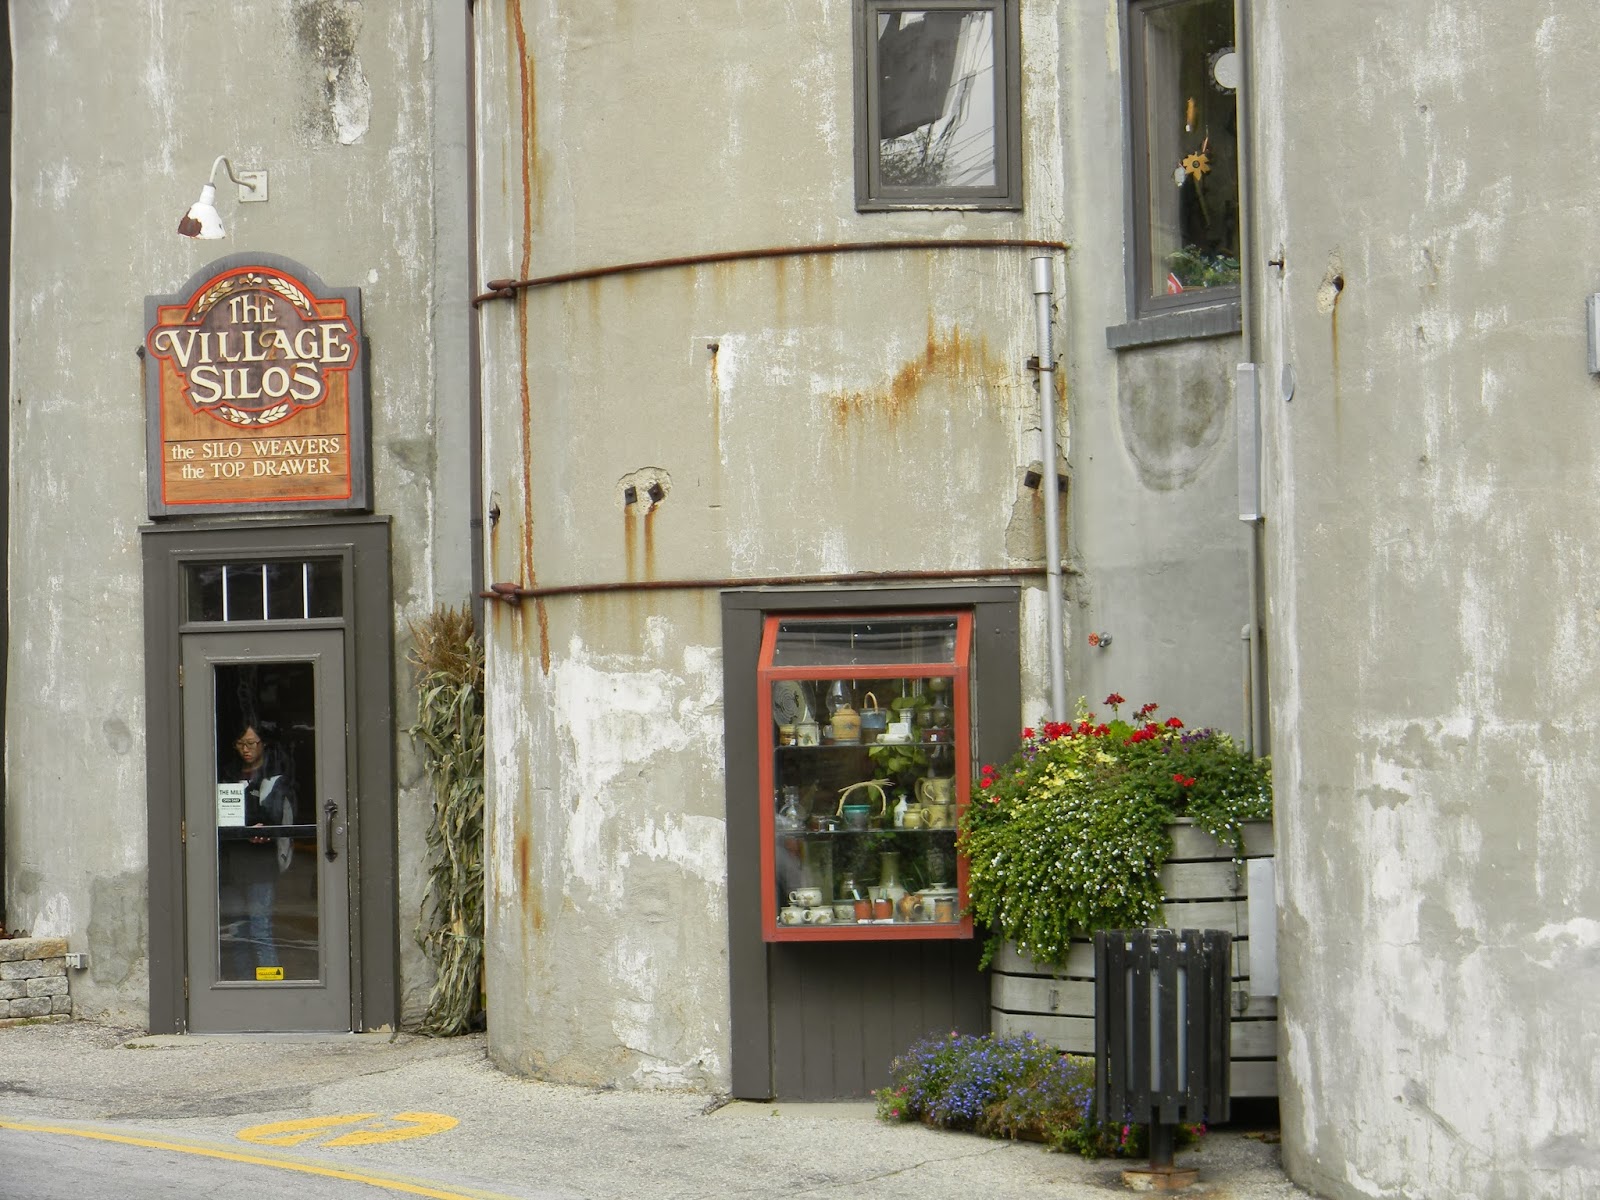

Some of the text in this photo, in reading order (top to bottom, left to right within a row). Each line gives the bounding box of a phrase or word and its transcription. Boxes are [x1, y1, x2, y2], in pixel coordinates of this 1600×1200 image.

[155, 324, 350, 367] VILLAGE
[190, 363, 321, 403] SILOS
[172, 438, 340, 460] the SILO WEAVERS
[182, 459, 331, 479] the TOP DRAWER
